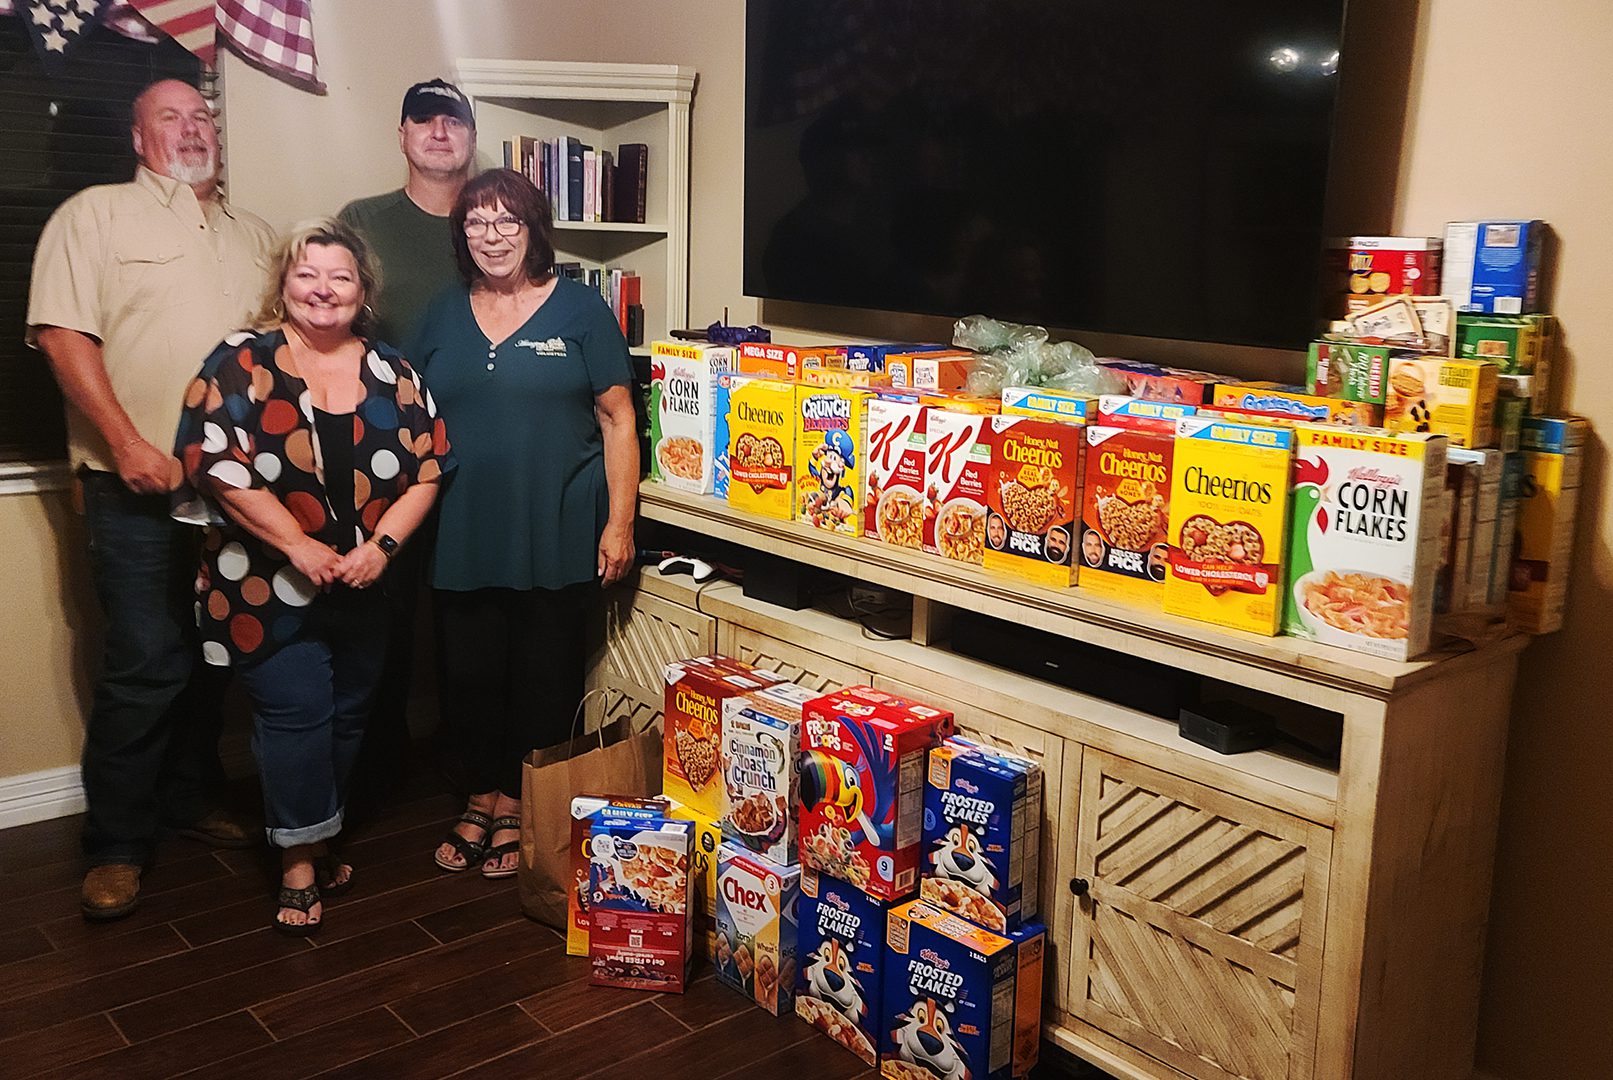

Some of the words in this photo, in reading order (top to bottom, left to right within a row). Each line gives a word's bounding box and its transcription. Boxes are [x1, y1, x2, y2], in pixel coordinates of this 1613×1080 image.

[657, 346, 681, 357] FAMILY
[682, 350, 698, 359] SIZE
[744, 346, 765, 358] MEGA
[766, 349, 784, 361] SIZE
[669, 378, 700, 400] CORN
[669, 397, 700, 416] FLAKES
[738, 401, 784, 426] Cheerios
[802, 398, 851, 419] CRUNCH
[869, 415, 911, 471] K
[1045, 439, 1059, 450] Nut
[1312, 433, 1369, 452] FAMILY
[1373, 442, 1408, 456] SIZE
[903, 457, 916, 467] Red
[928, 425, 973, 483] K
[1003, 439, 1063, 469] Cheerios
[1148, 451, 1163, 462] Nut
[898, 465, 920, 476] Berries
[965, 469, 978, 479] Red
[1100, 452, 1167, 483] Cheerios
[959, 477, 982, 488] Berries
[1184, 465, 1272, 505] Cheerios
[1338, 482, 1409, 517] CORN
[1336, 510, 1407, 542] FLAKES
[1010, 536, 1041, 555] PICK
[1108, 555, 1145, 573] PICK
[1174, 563, 1202, 577] LOWER
[1200, 570, 1254, 582] CHOLESTEROL
[676, 691, 718, 725] Cheerios
[806, 720, 841, 736] FROOT
[731, 738, 776, 760] Cinnamon
[809, 734, 841, 751] LOOPS
[884, 733, 893, 746] 2
[739, 754, 767, 773] Toast
[734, 765, 776, 790] Crunch
[941, 791, 995, 814] FROSTED
[943, 804, 989, 825] FLAKES
[881, 861, 888, 871] 9
[723, 877, 768, 913] Chex
[816, 902, 861, 928] FROSTED
[818, 915, 856, 939] FLAKES
[973, 952, 987, 963] BAGS
[907, 959, 964, 987] FROSTED
[910, 974, 958, 999] FLAKES
